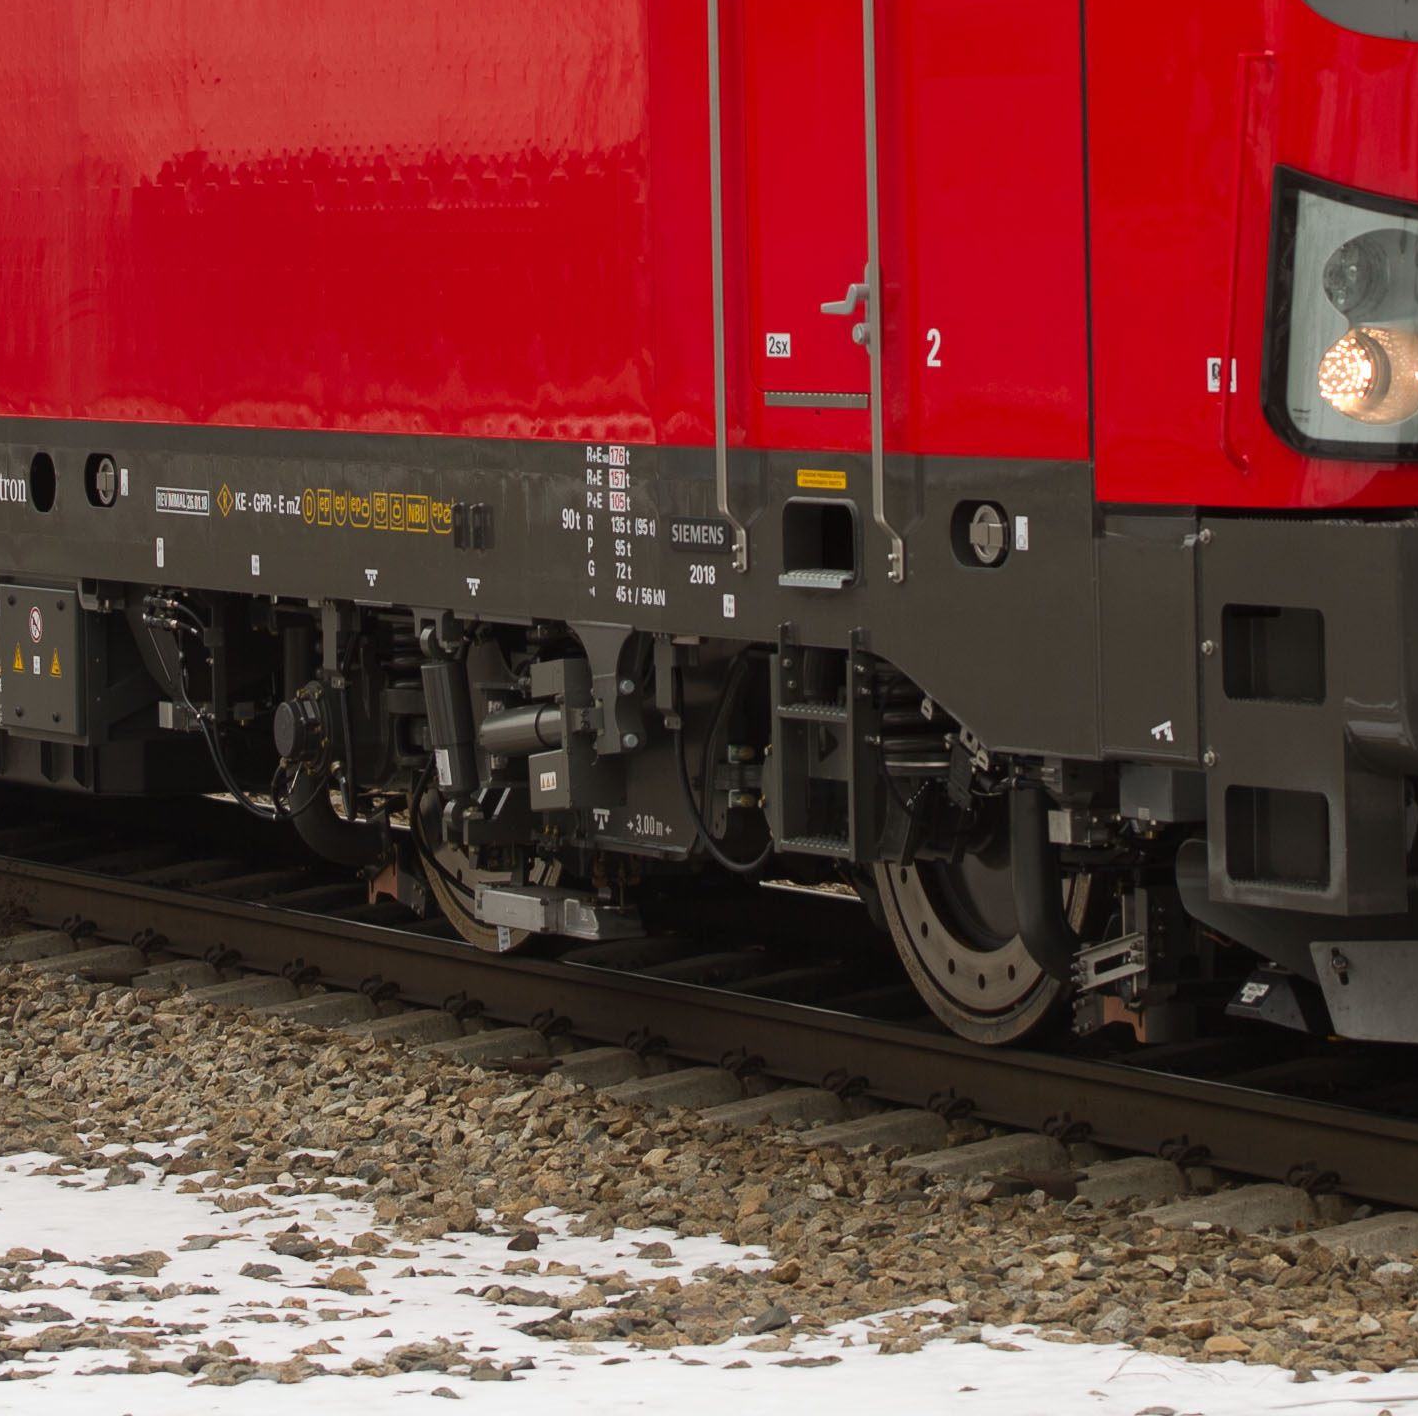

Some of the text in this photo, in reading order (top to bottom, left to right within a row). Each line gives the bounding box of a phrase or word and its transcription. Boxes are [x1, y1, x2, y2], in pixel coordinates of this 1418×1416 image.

[768, 336, 789, 355] 2sx
[926, 328, 942, 367] 2
[610, 448, 624, 465] 176
[586, 469, 603, 486] R+E
[610, 471, 624, 488] 157
[234, 492, 247, 512] KE
[253, 493, 272, 514] GPR
[586, 491, 603, 509] P+E
[610, 494, 625, 511] 105
[408, 500, 427, 524] NBÜ
[562, 508, 575, 530] 90
[587, 514, 594, 531] R
[611, 516, 626, 534] 135
[672, 524, 725, 545] SIEMENS
[587, 537, 594, 553] P
[615, 539, 626, 556] 95
[588, 560, 595, 577] G
[615, 562, 627, 579] 72
[689, 564, 716, 585] 2018
[615, 586, 627, 602] 45
[641, 588, 653, 605] 56
[653, 589, 666, 607] kN
